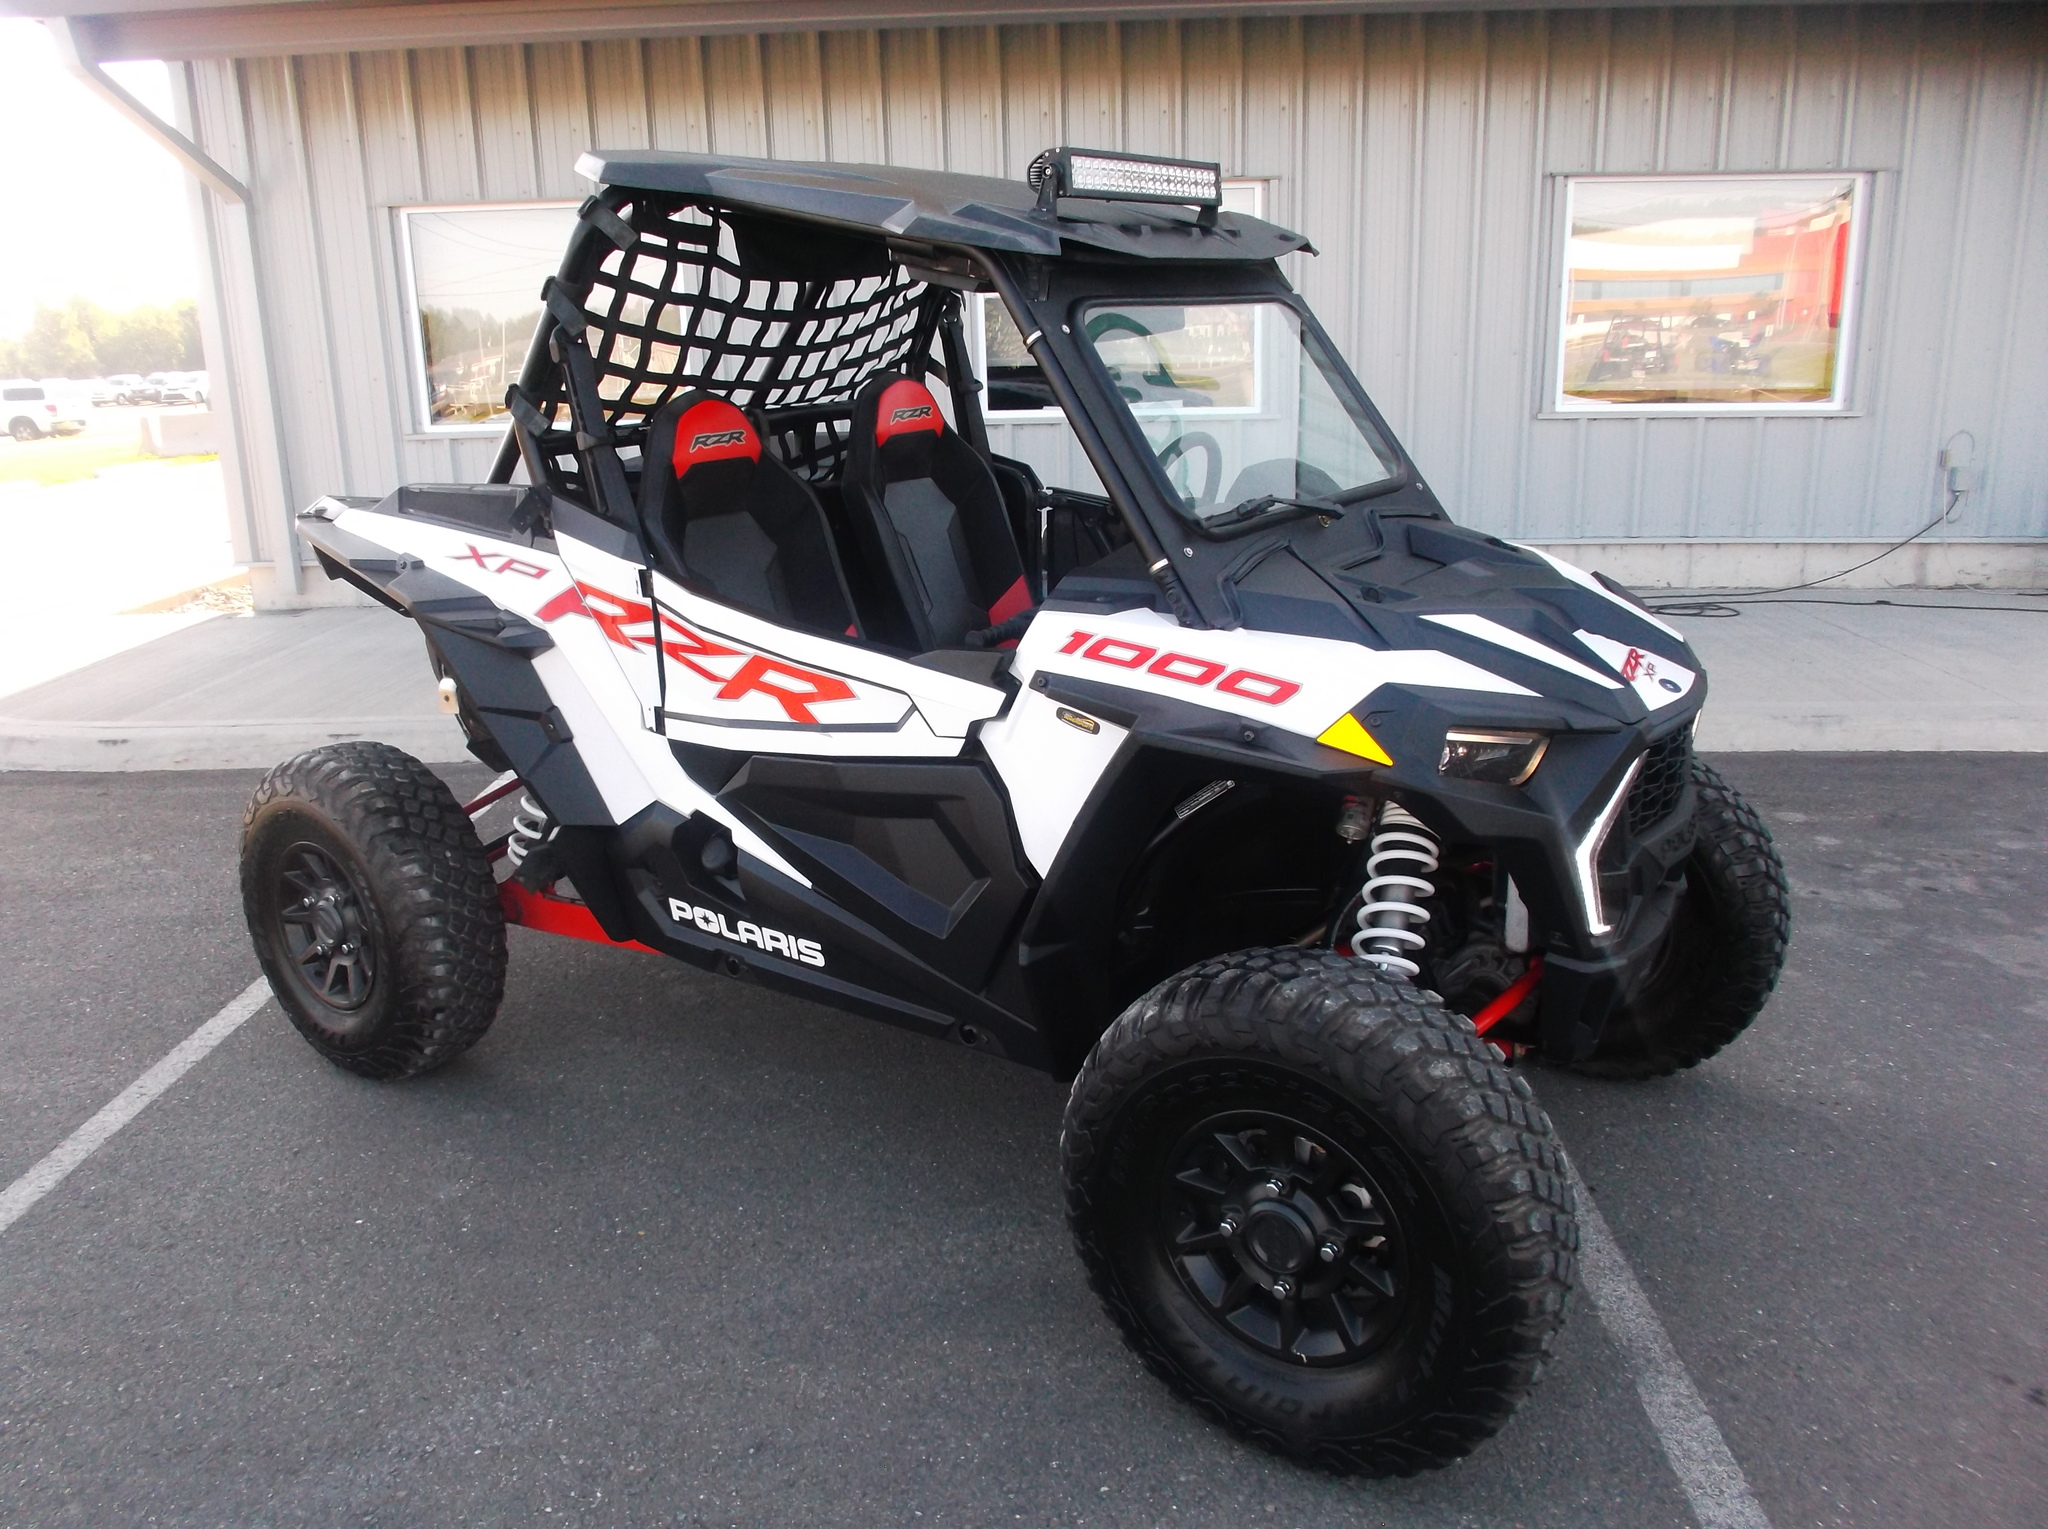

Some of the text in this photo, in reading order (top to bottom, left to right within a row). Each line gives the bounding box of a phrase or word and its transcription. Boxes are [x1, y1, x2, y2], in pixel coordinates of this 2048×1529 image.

[890, 405, 933, 425] RZR
[690, 430, 746, 453] RZR
[449, 543, 551, 580] XP
[534, 580, 858, 725] RZR
[1057, 630, 1303, 707] 1000
[1644, 661, 1657, 682] XP
[668, 897, 826, 968] POLARIS
